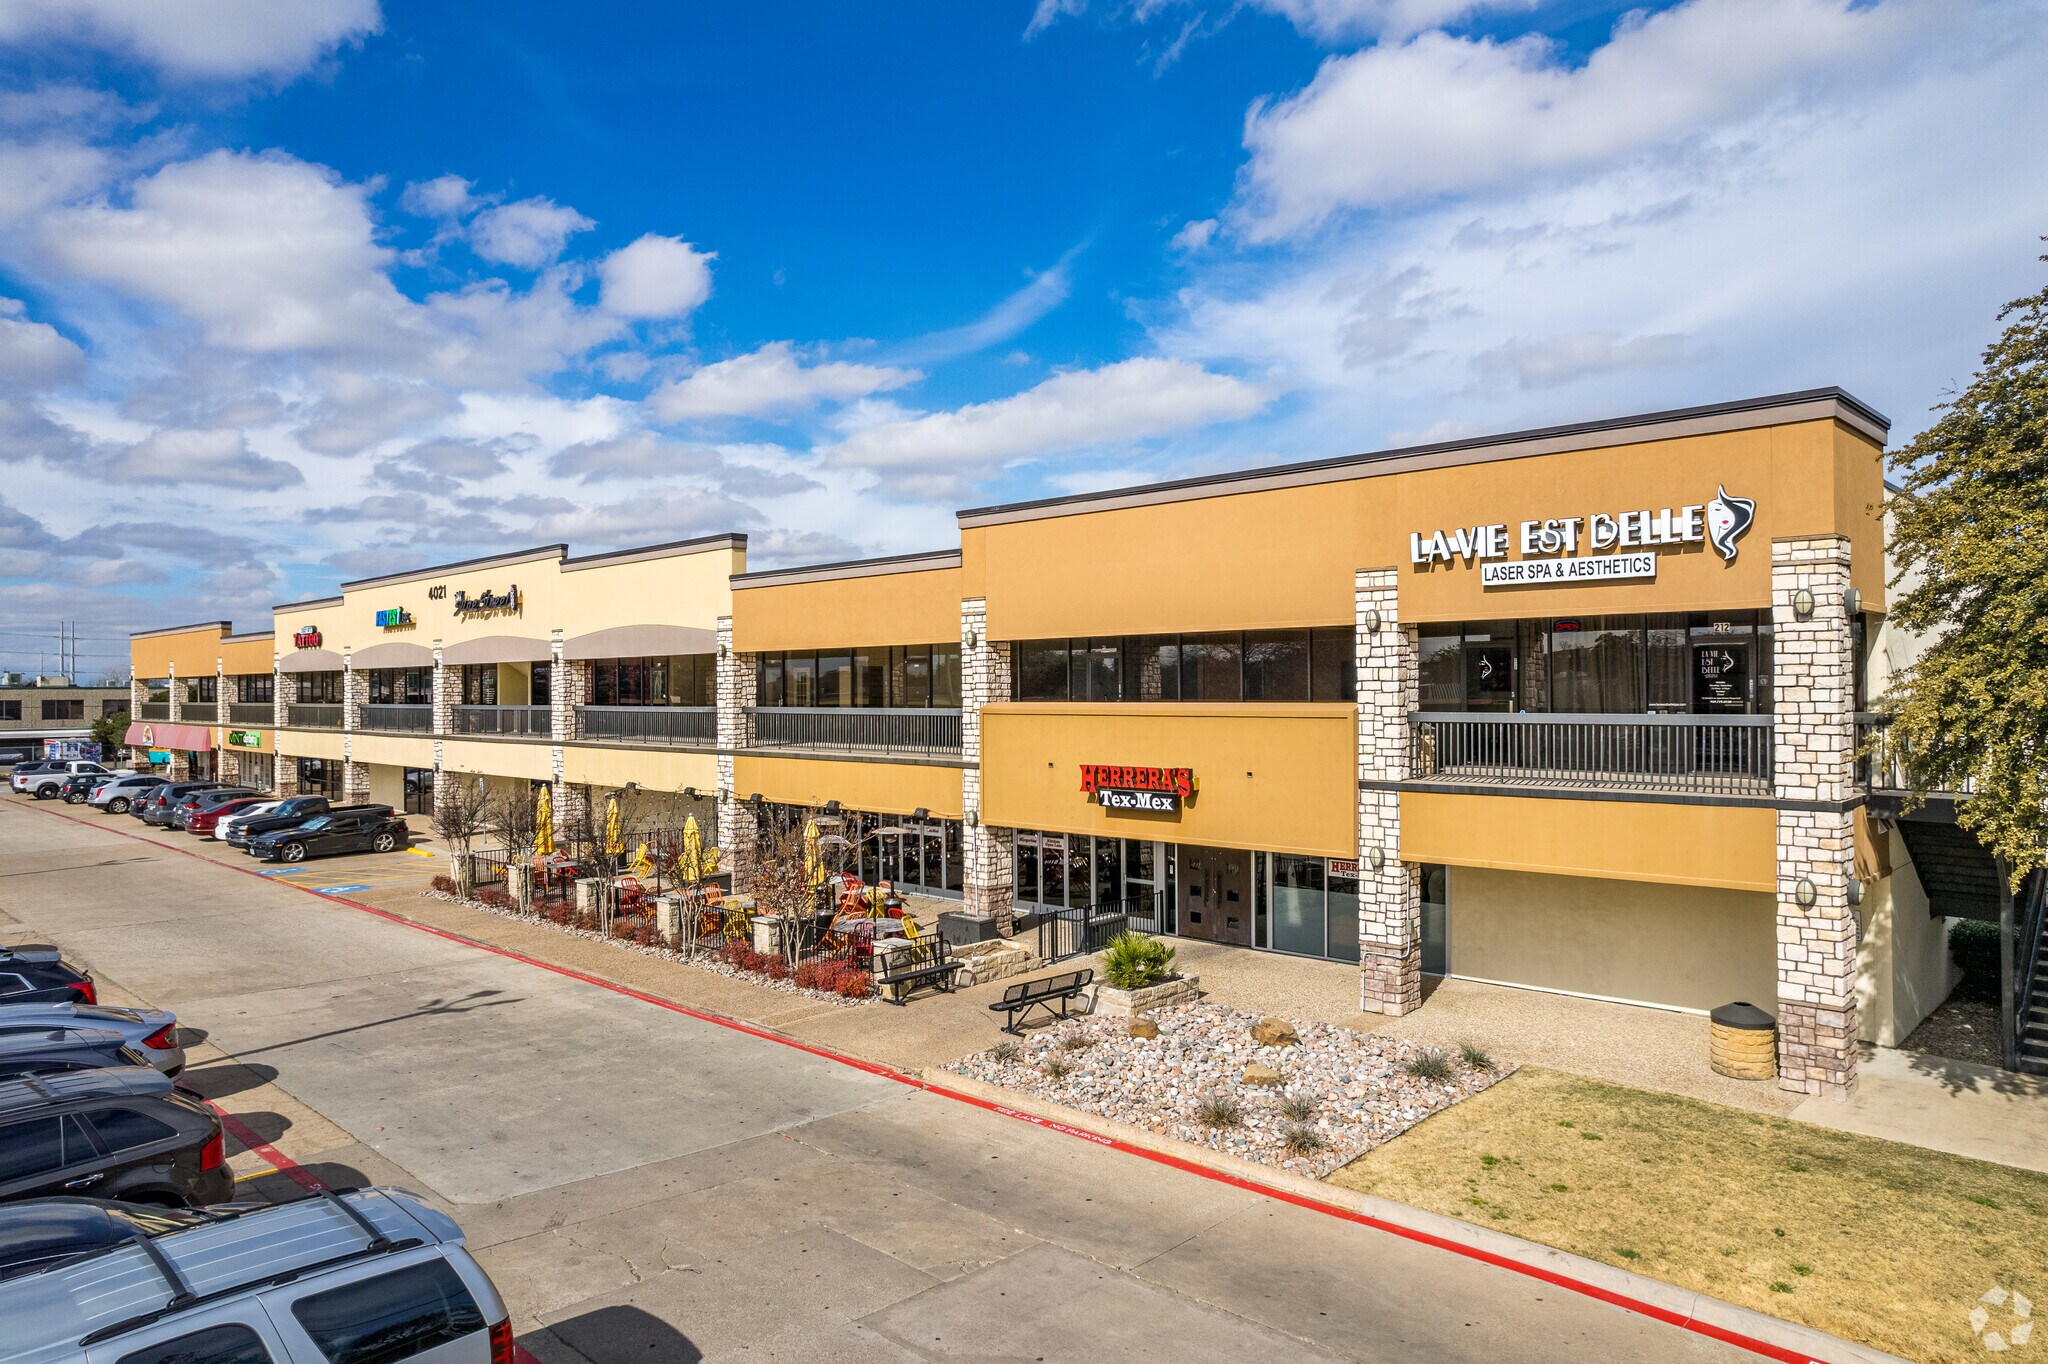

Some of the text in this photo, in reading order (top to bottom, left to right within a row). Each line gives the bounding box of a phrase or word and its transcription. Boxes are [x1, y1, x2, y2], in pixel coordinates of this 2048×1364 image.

[1409, 505, 1704, 563] LA VIE EST BELLE
[1484, 557, 1651, 581] LASER SPA & AESTHETICS
[428, 584, 446, 600] 4021
[1555, 622, 1579, 631] OPEN
[1714, 623, 1730, 632] 212
[293, 633, 319, 647] TATTOO
[1079, 765, 1191, 797] HERRERA'S
[1100, 790, 1174, 811] Tex-Mex
[1331, 861, 1359, 872] HERR
[1015, 1113, 1043, 1124] LANE
[1049, 1123, 1066, 1131] NO
